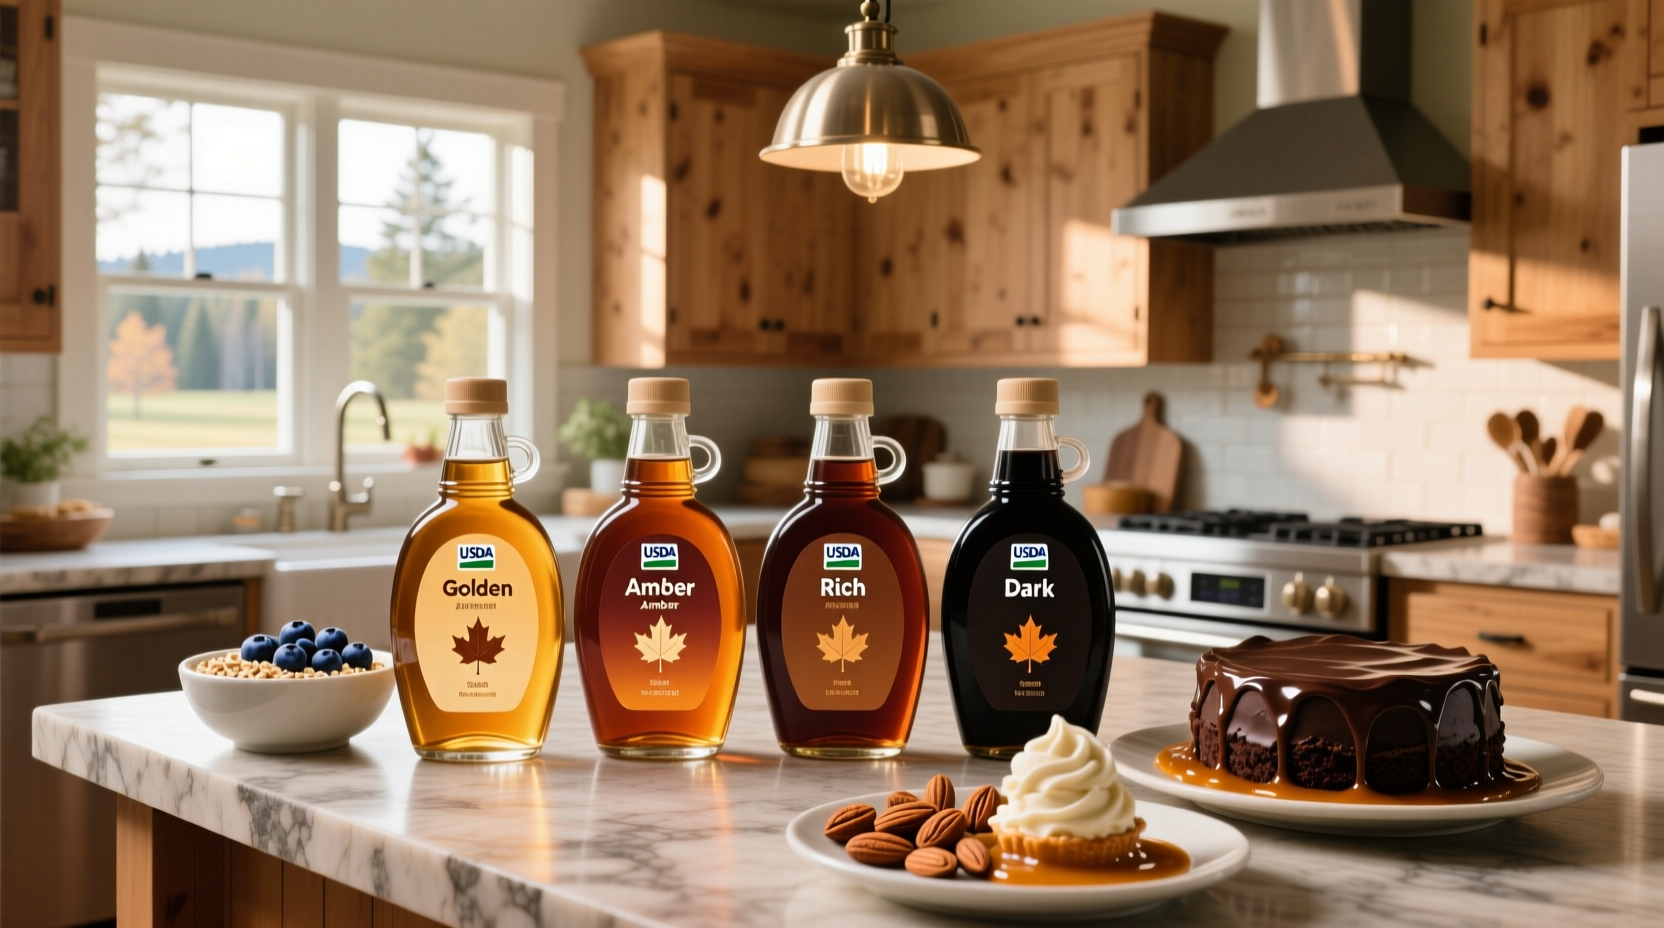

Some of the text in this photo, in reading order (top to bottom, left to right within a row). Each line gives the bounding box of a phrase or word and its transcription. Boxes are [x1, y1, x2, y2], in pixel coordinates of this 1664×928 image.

[460, 547, 494, 559] USDA
[644, 546, 676, 558] USDA
[826, 546, 860, 558] USDA
[1013, 546, 1046, 558] USDA
[442, 578, 513, 597] Golden
[625, 577, 696, 596] Amber
[820, 577, 866, 597] Rich
[1004, 578, 1055, 598] Dark
